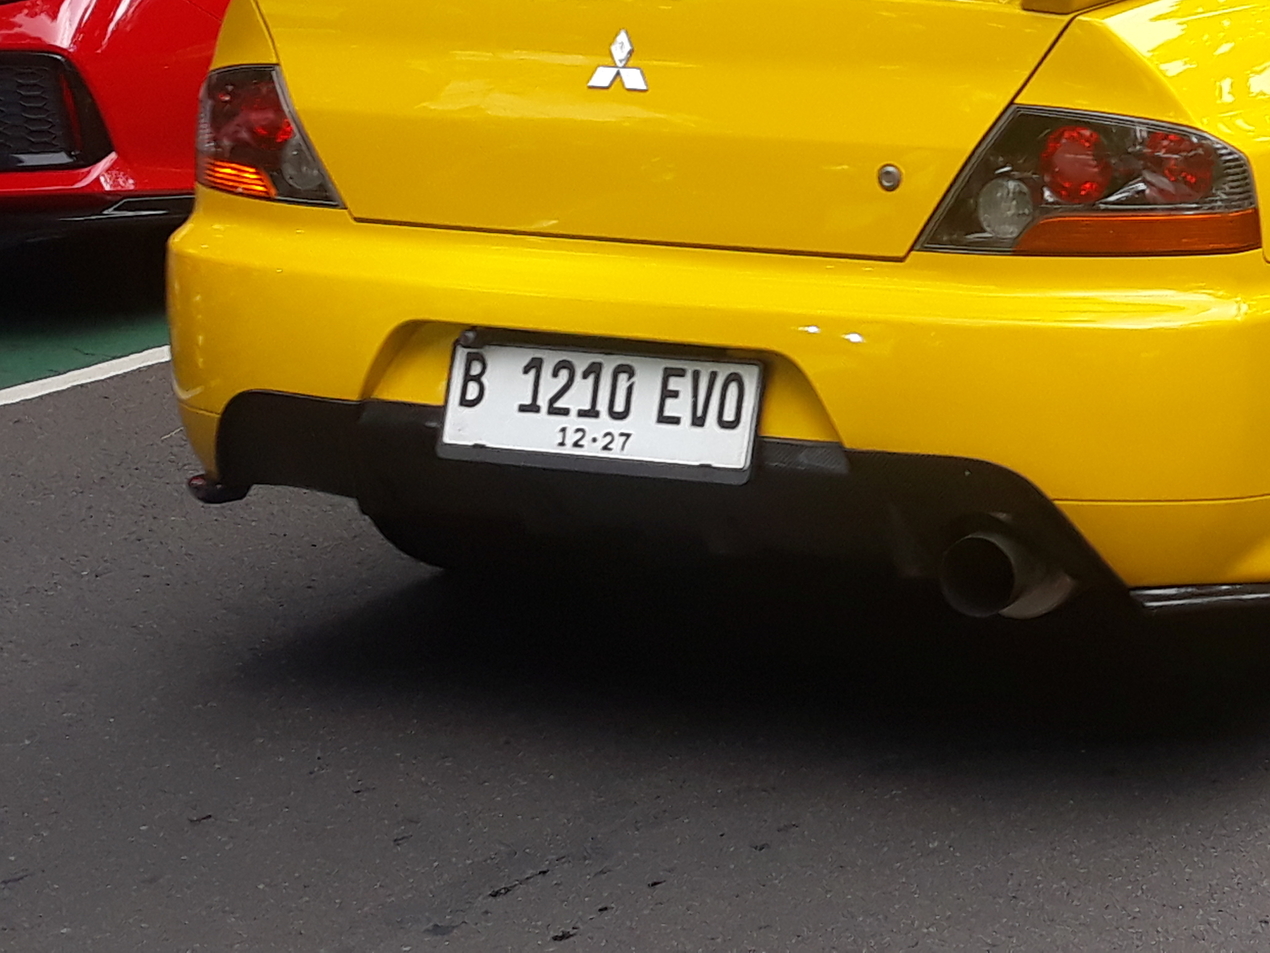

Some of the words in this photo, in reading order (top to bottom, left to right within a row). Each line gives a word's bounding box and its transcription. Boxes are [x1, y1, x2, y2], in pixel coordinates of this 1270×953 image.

[458, 351, 487, 408] B
[517, 356, 636, 421] 1210
[655, 366, 746, 430] EVO
